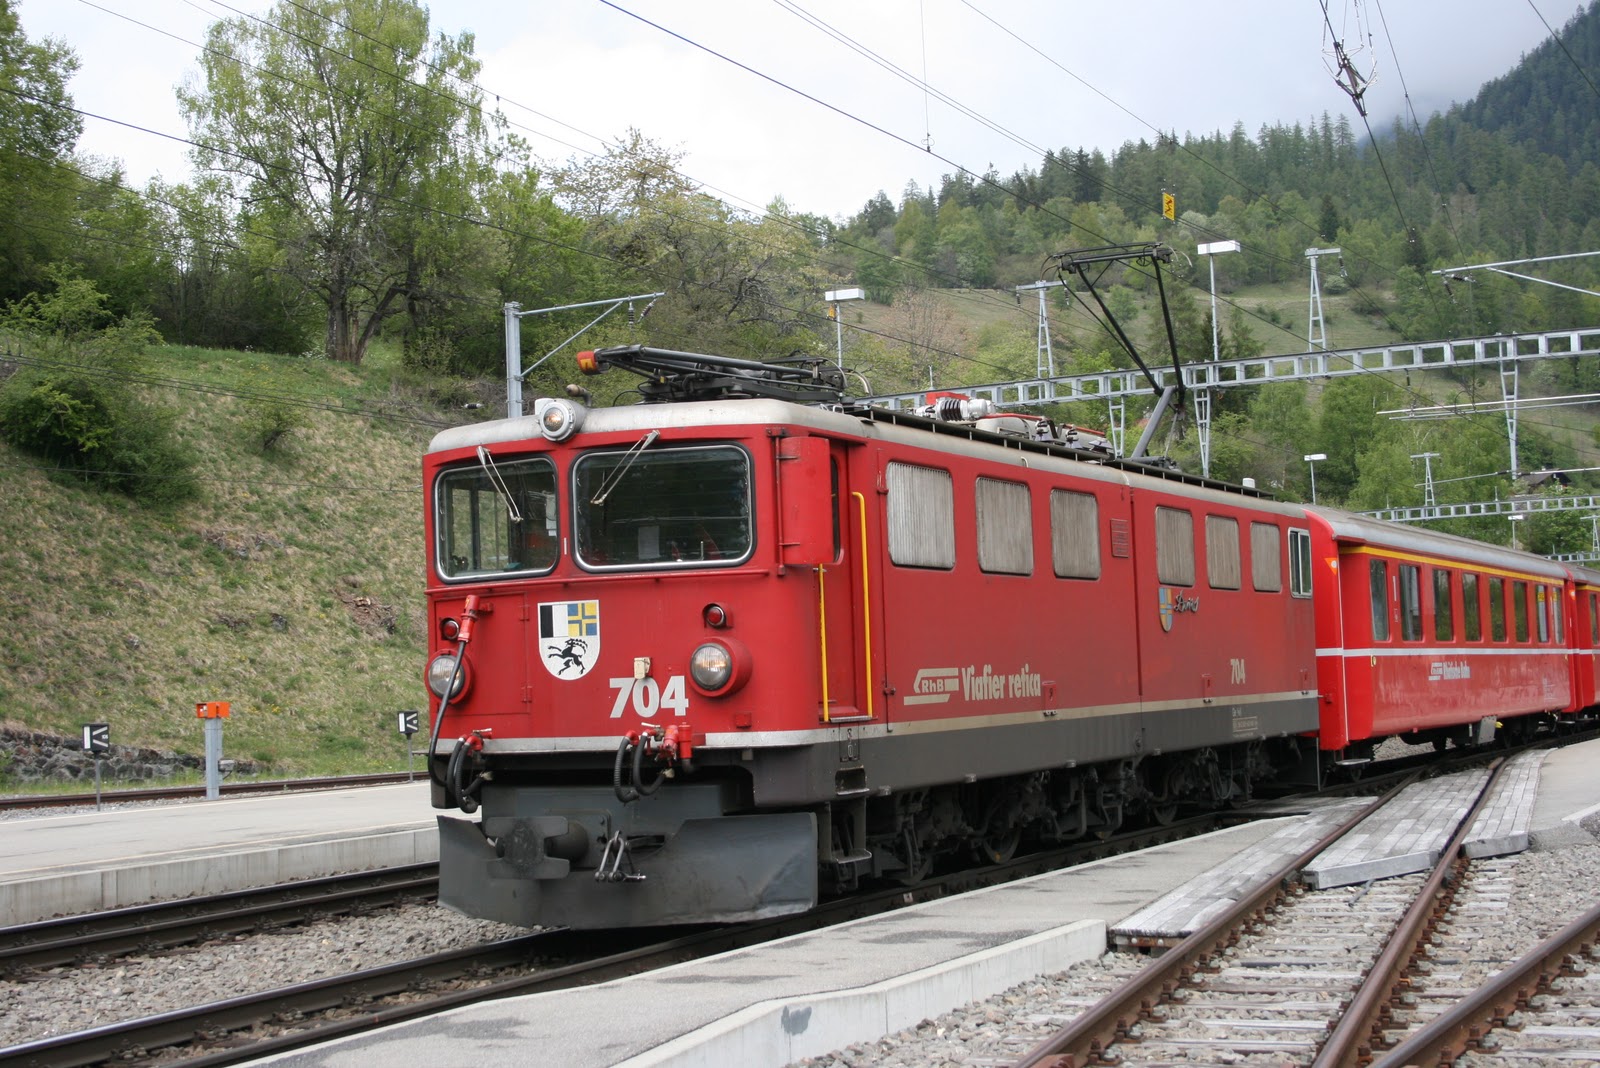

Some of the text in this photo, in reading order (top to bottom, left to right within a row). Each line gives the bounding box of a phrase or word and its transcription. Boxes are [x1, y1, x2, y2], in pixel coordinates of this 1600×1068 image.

[961, 663, 1042, 701] Viafier retica
[1230, 658, 1246, 685] 704
[609, 675, 689, 718] 704
